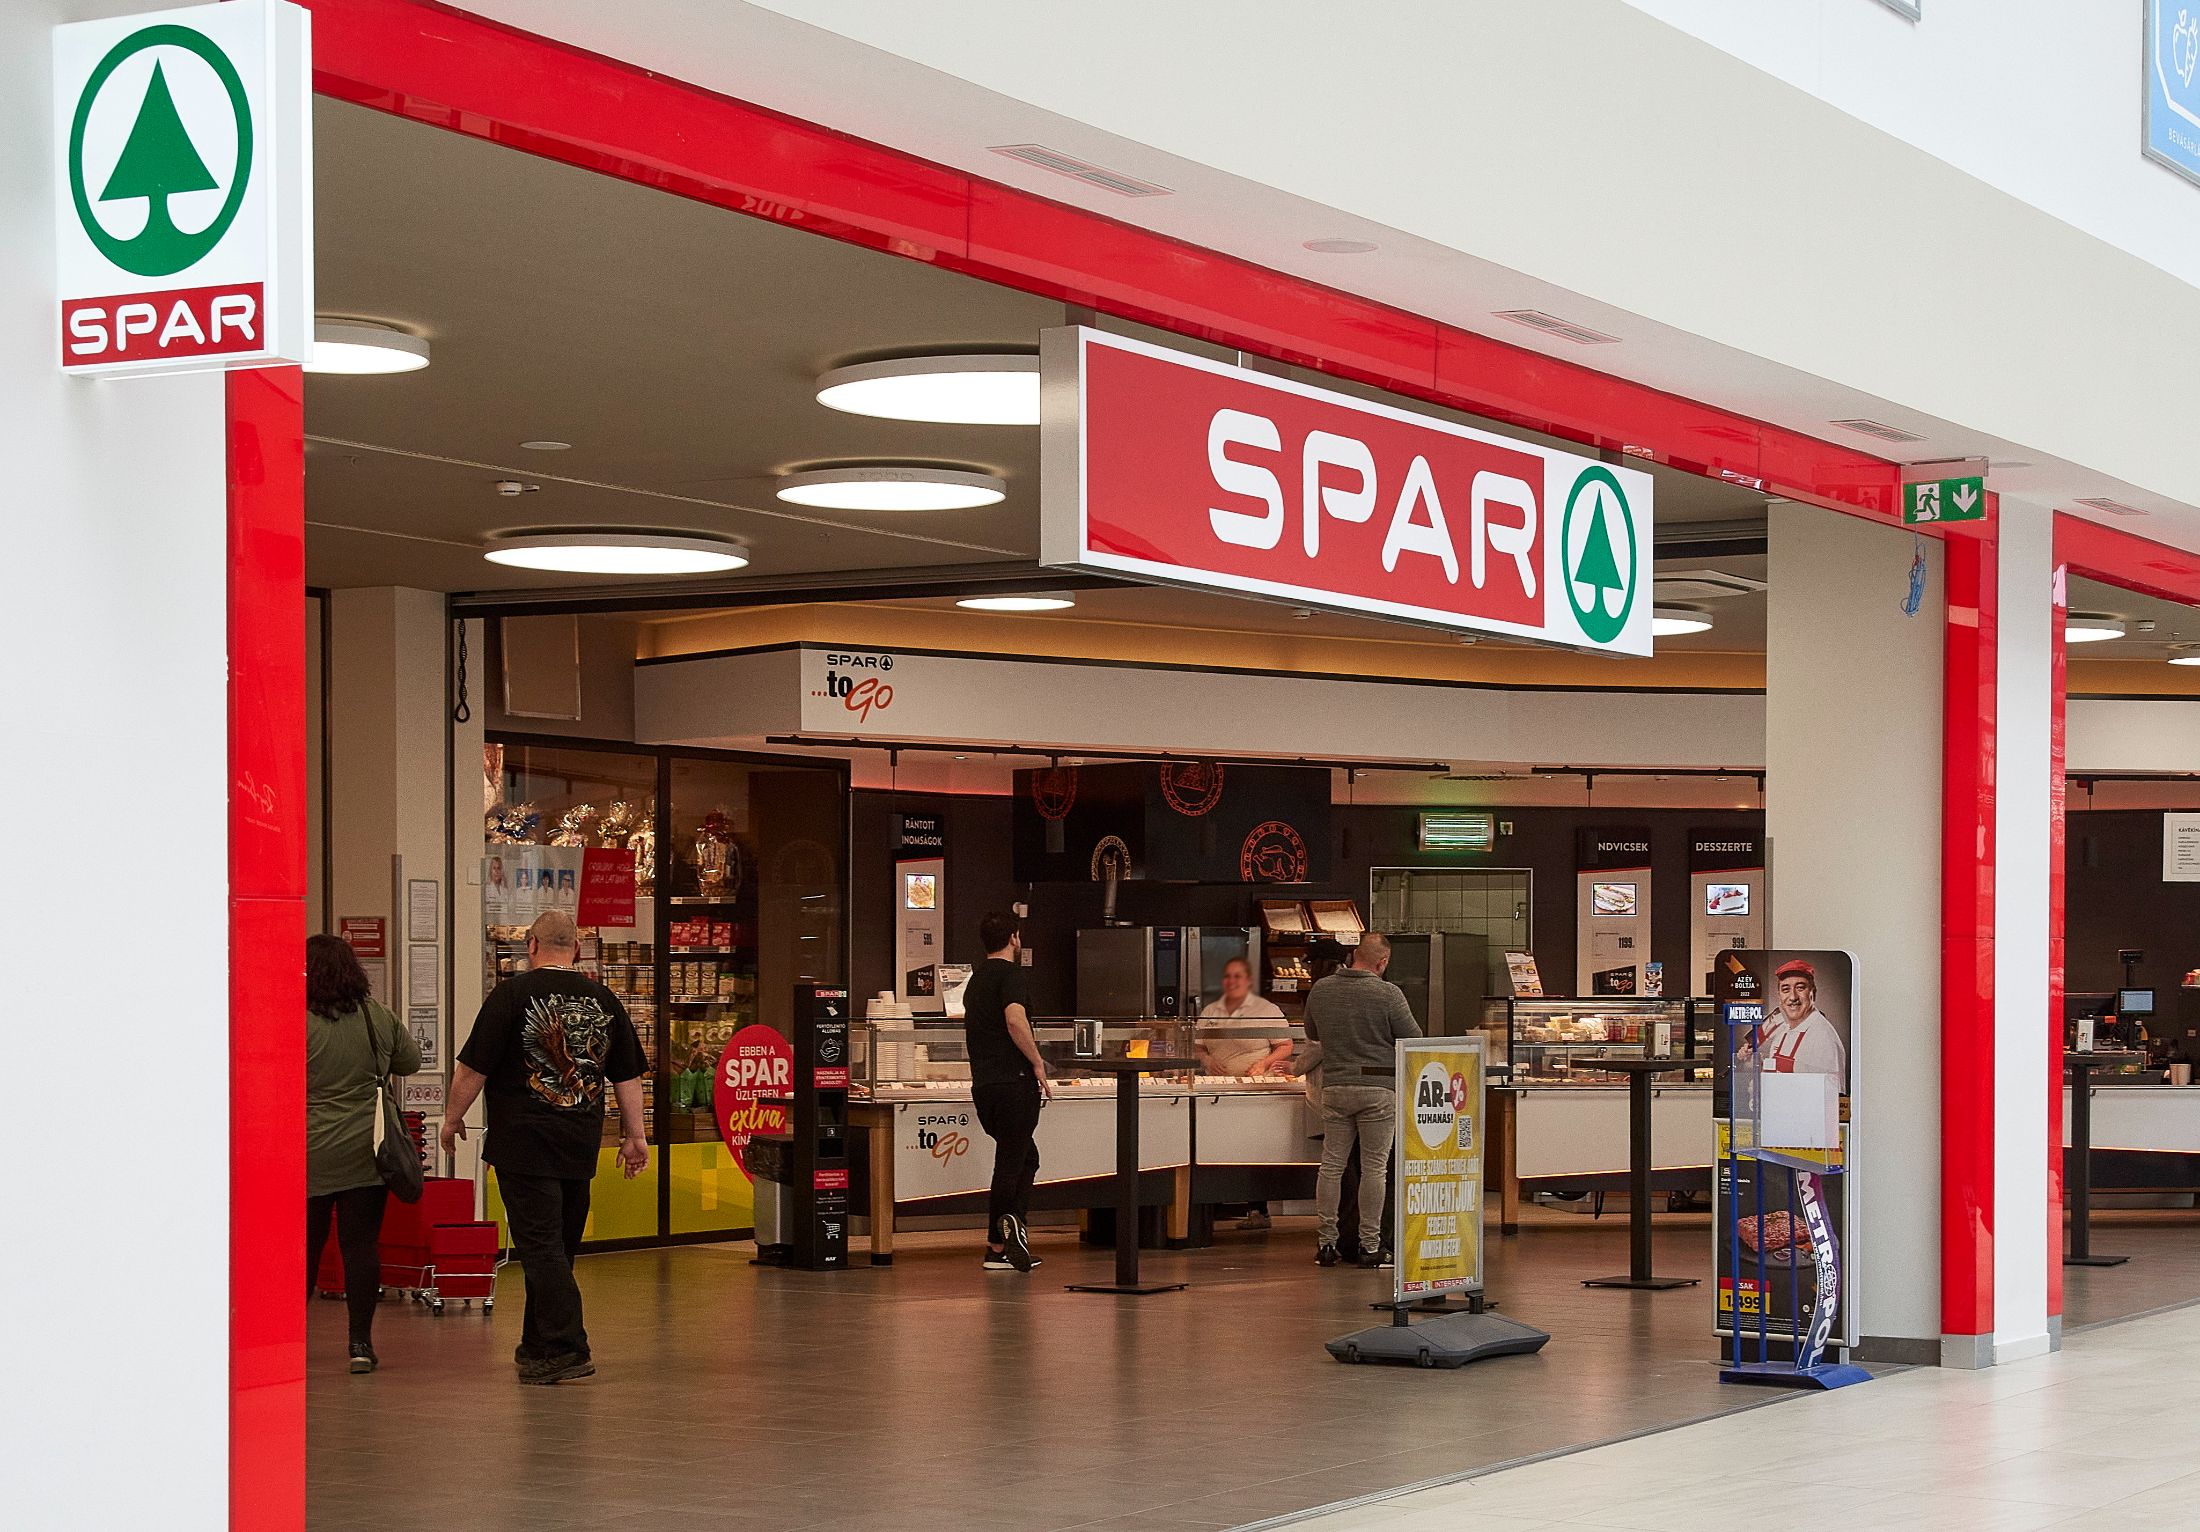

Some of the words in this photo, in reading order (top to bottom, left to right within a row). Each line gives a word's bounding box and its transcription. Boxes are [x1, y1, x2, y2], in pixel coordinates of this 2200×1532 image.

[69, 293, 257, 356] SPAR
[1206, 407, 1538, 600] SPAR
[826, 653, 877, 668] SPAR
[905, 817, 935, 831] RÁNTOTT
[901, 833, 943, 846] INOMSÁGOK
[1597, 842, 1649, 852] NDVICSEK
[1695, 842, 1753, 852] DESSZERTE
[1732, 937, 1745, 949] 999
[1745, 974, 1753, 983] ÉV
[1729, 1006, 1763, 1020] METROPOL
[739, 1046, 767, 1057] EBBEN
[769, 1046, 776, 1056] A
[725, 1058, 789, 1088] SPAR
[729, 1097, 785, 1133] extra
[918, 1115, 957, 1126] SPAR
[1417, 1111, 1454, 1124] ZUHANÁS!
[731, 1133, 751, 1146] KÍNÁ
[1798, 1172, 1837, 1367] METROPOL
[1738, 1282, 1754, 1290] SAK
